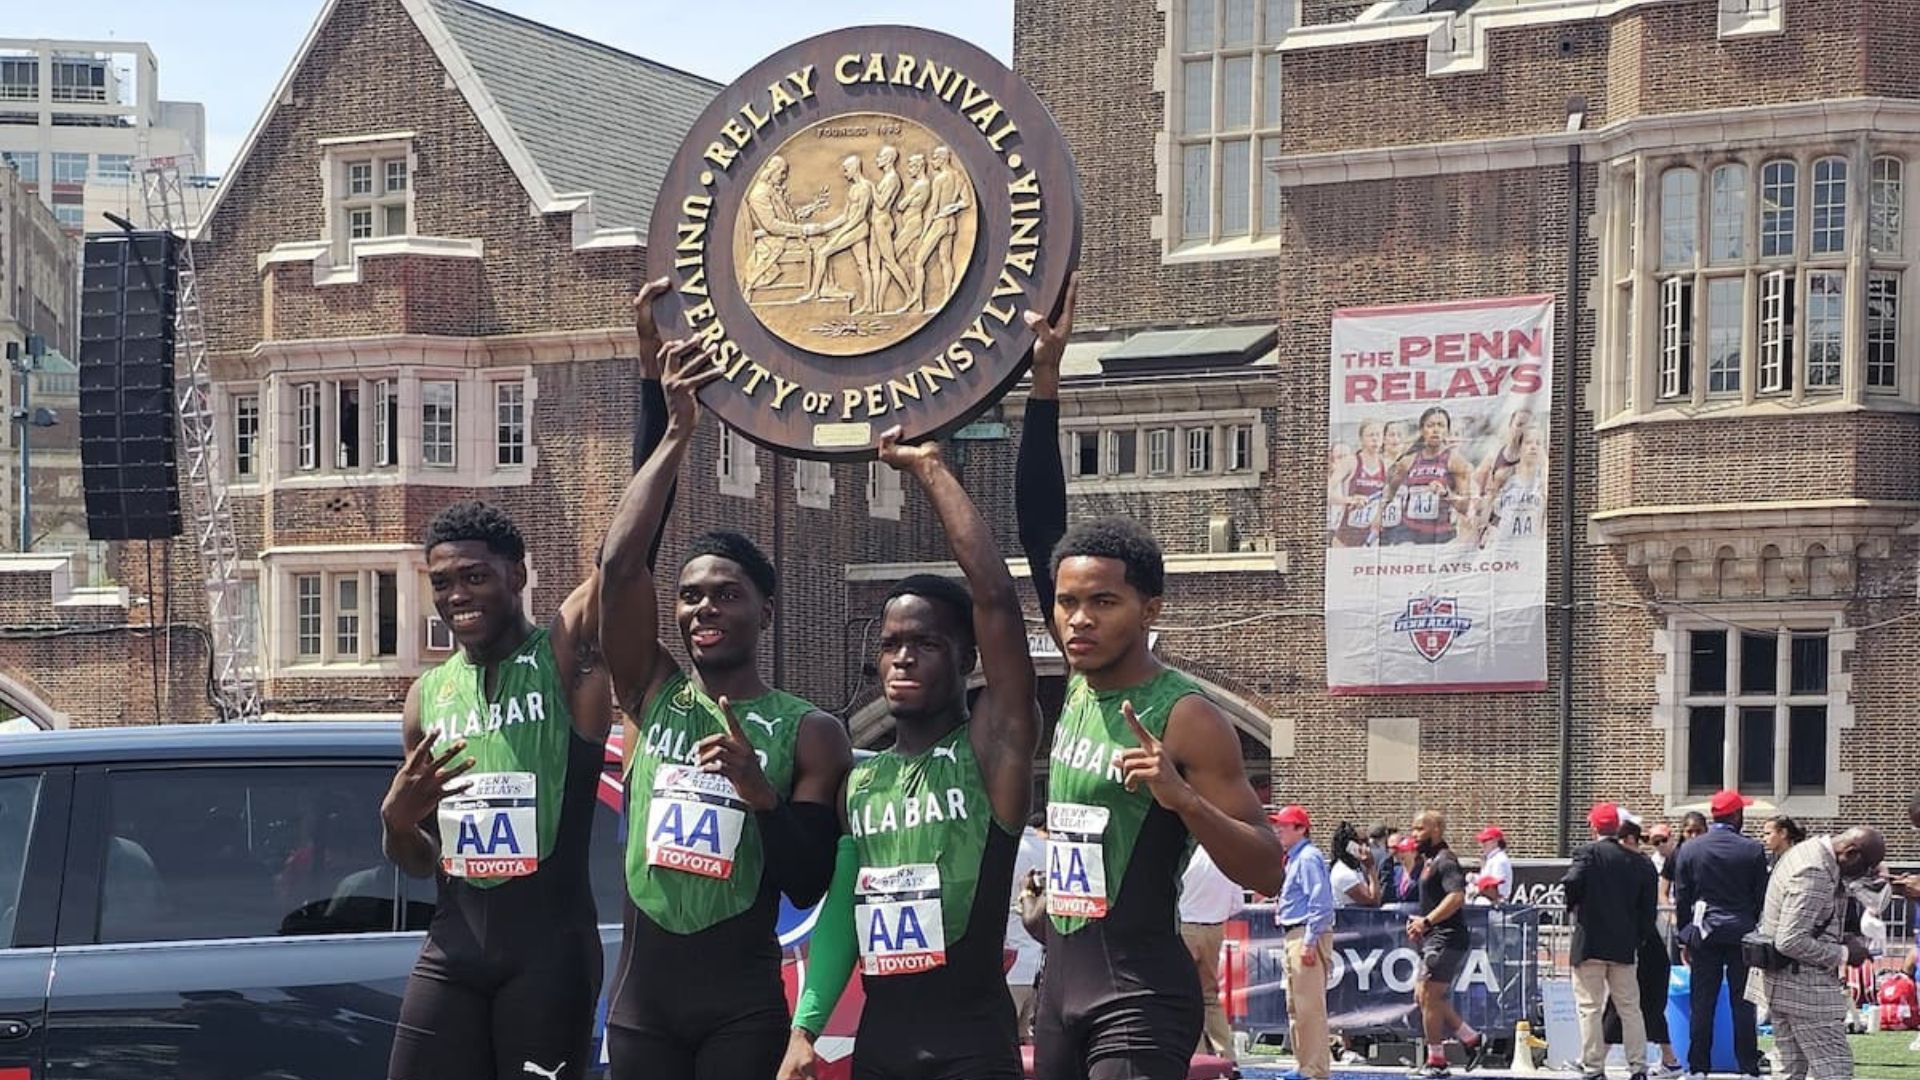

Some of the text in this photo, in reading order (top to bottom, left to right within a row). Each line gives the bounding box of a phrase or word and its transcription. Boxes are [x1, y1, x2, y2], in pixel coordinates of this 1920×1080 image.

[704, 53, 1020, 170] RELAY CARNIVAL
[675, 195, 801, 411] UNIVERSITY
[841, 169, 1041, 420] PENNSYLVANIA
[1341, 328, 1543, 369] THE PENN
[1344, 364, 1543, 404] RELAYS
[1512, 515, 1532, 535] AA
[1353, 561, 1519, 576] PENNRELAYS.COM
[644, 722, 768, 773] CALA
[1050, 721, 1124, 784] ALABAR
[456, 813, 521, 855] AA
[652, 803, 721, 855] AA
[852, 788, 968, 840] ALABAR
[468, 861, 527, 873] TOYOTA
[661, 850, 723, 875] TOYOTA
[1049, 845, 1091, 893] AA
[868, 905, 928, 952] AA
[880, 955, 937, 971] TOYOTA
[1268, 947, 1501, 993] YOA
